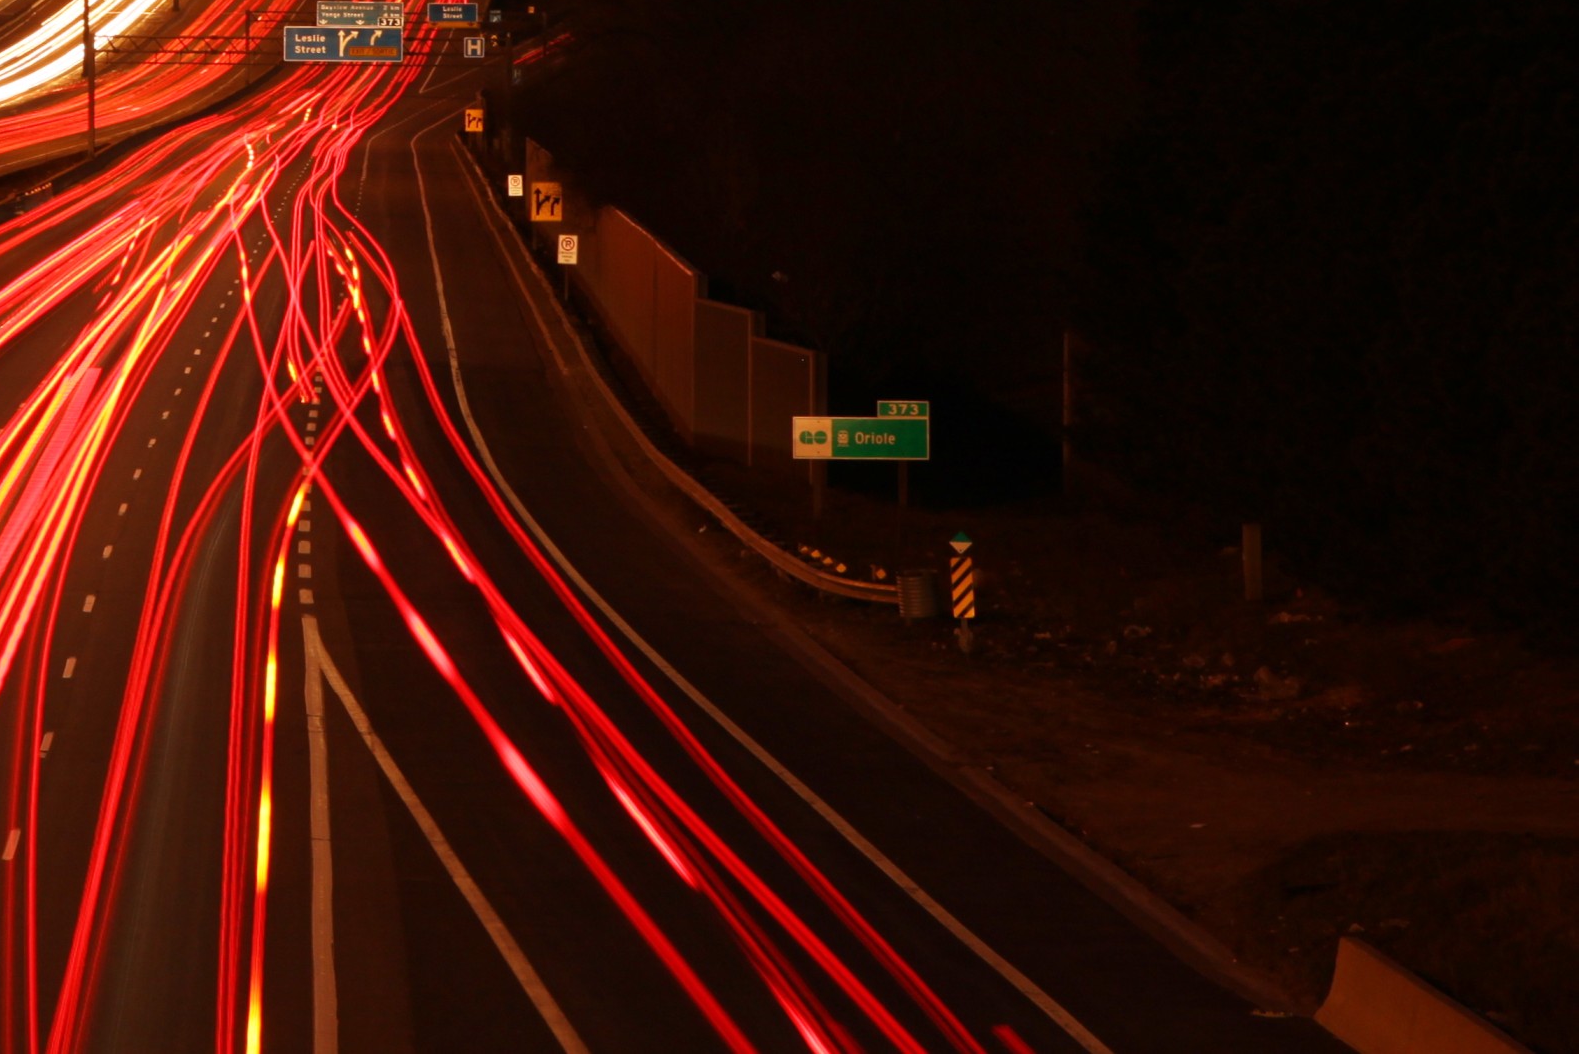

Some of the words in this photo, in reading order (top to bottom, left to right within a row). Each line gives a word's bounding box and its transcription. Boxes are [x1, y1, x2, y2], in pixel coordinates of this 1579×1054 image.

[380, 18, 401, 26] 373
[294, 34, 326, 43] Leslie
[294, 46, 327, 54] Street
[467, 39, 481, 56] H
[888, 403, 920, 415] 373
[854, 431, 896, 445] Oriole
